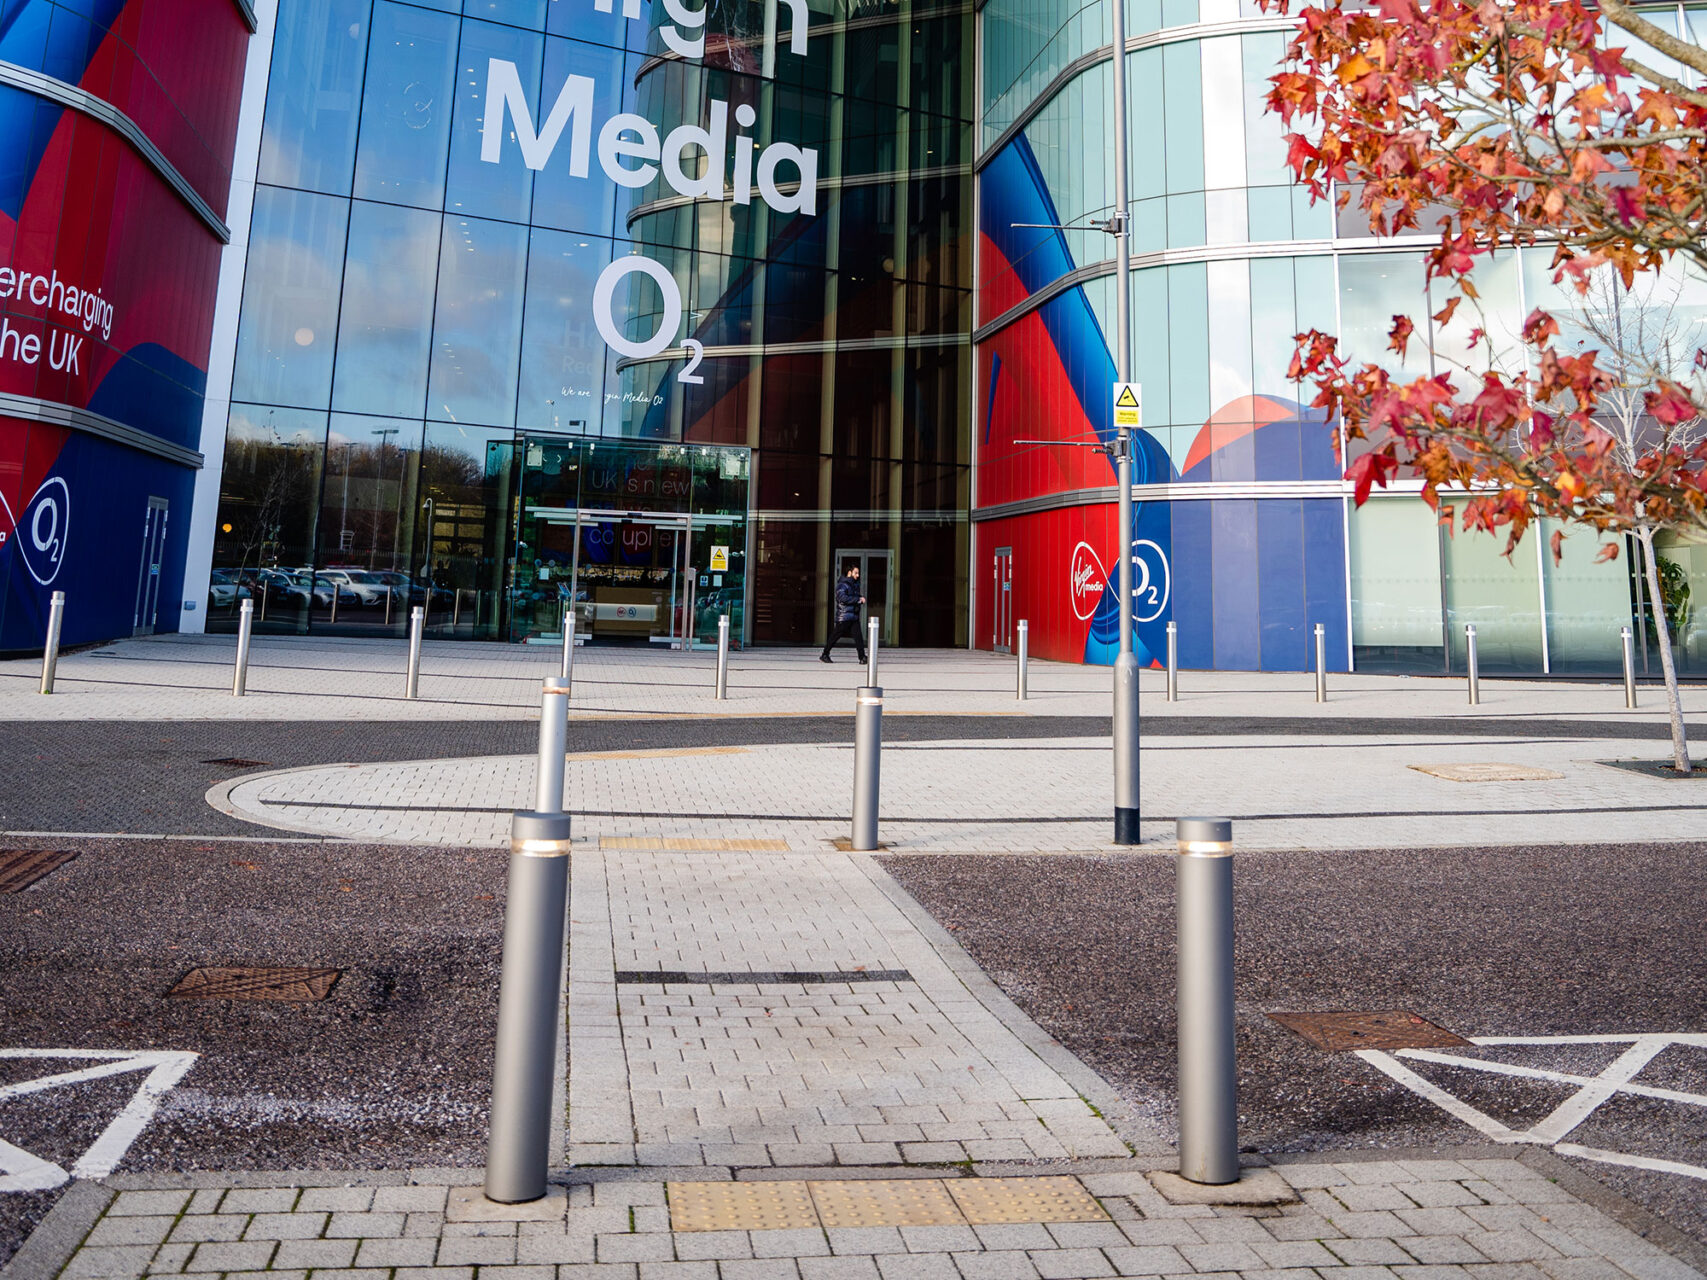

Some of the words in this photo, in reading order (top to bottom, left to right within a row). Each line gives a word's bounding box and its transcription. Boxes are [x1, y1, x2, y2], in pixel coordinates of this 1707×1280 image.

[480, 57, 819, 216] Media
[0, 267, 113, 341] ercharging
[592, 255, 704, 385] O2
[0, 317, 41, 364] he
[49, 329, 84, 376] UK
[622, 391, 652, 403] Media
[31, 496, 60, 562] O2
[1085, 581, 1104, 592] media
